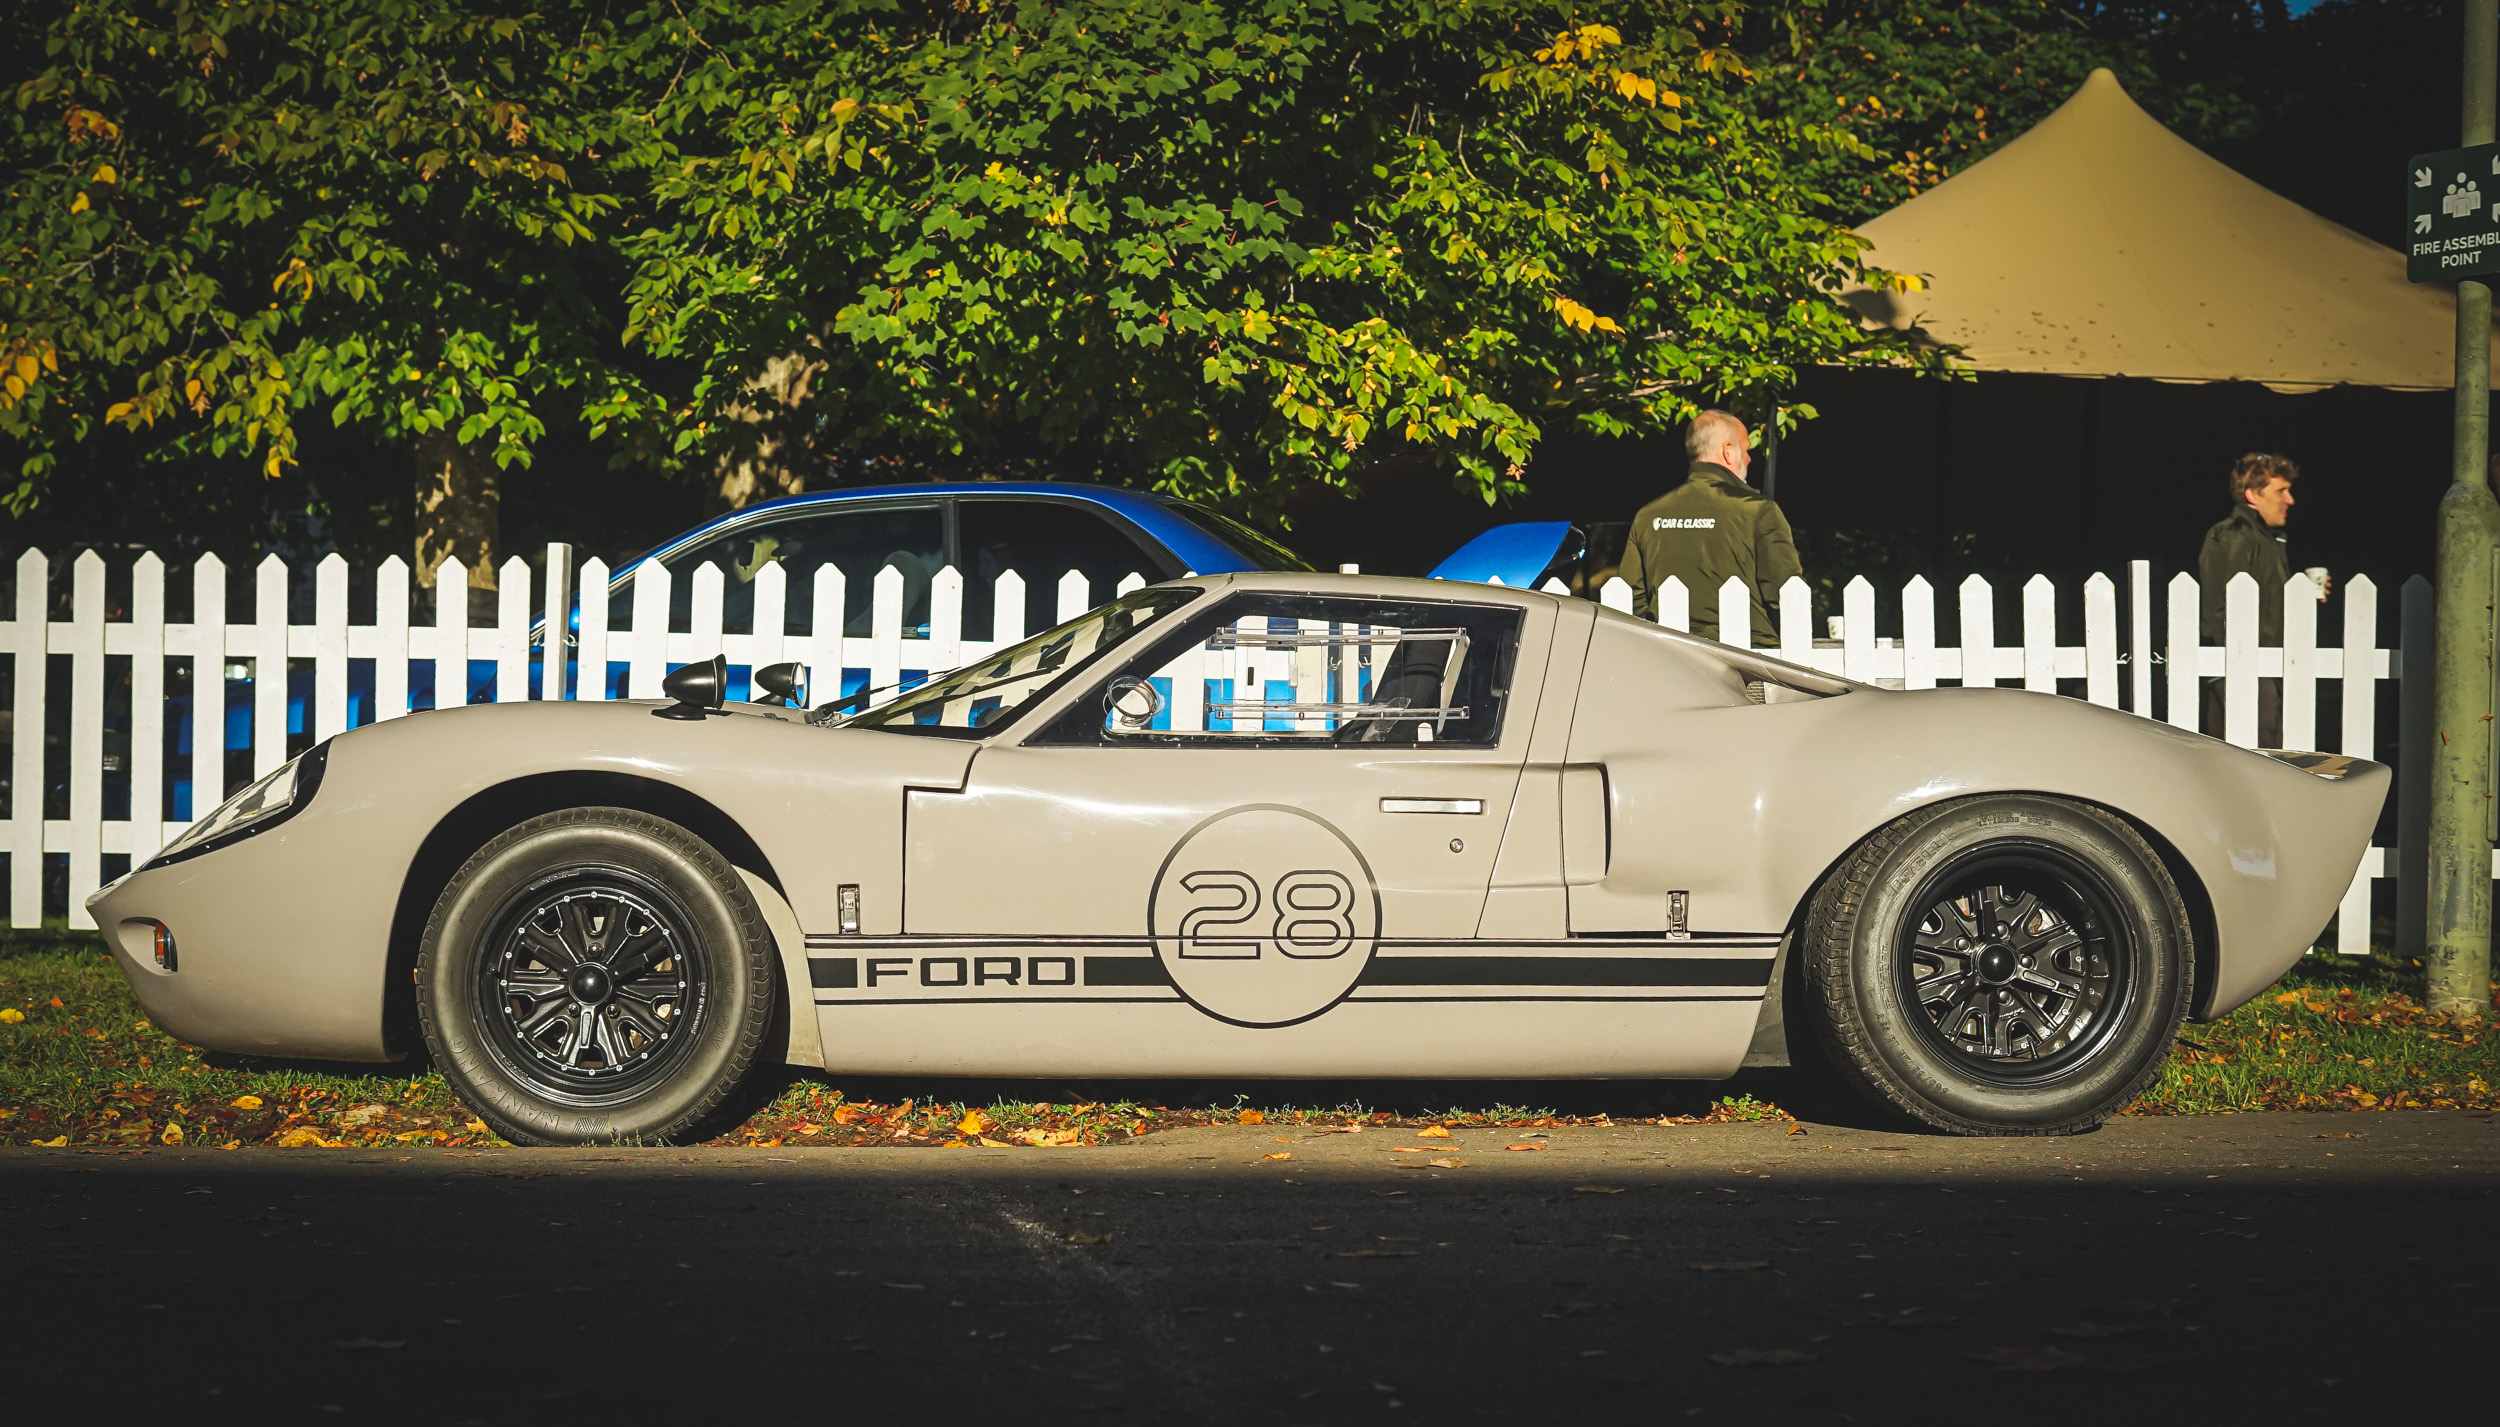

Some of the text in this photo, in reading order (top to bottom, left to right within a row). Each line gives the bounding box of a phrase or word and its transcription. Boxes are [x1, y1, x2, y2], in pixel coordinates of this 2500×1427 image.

[2413, 240, 2441, 256] FIRE
[2441, 250, 2482, 268] POINT
[1661, 518, 1716, 529] CAR & CLASSIC
[1883, 832, 1952, 901] PIRELLI
[1178, 869, 1356, 959] 28
[866, 956, 1076, 988] FORD
[448, 1034, 560, 1133] NANKANG
